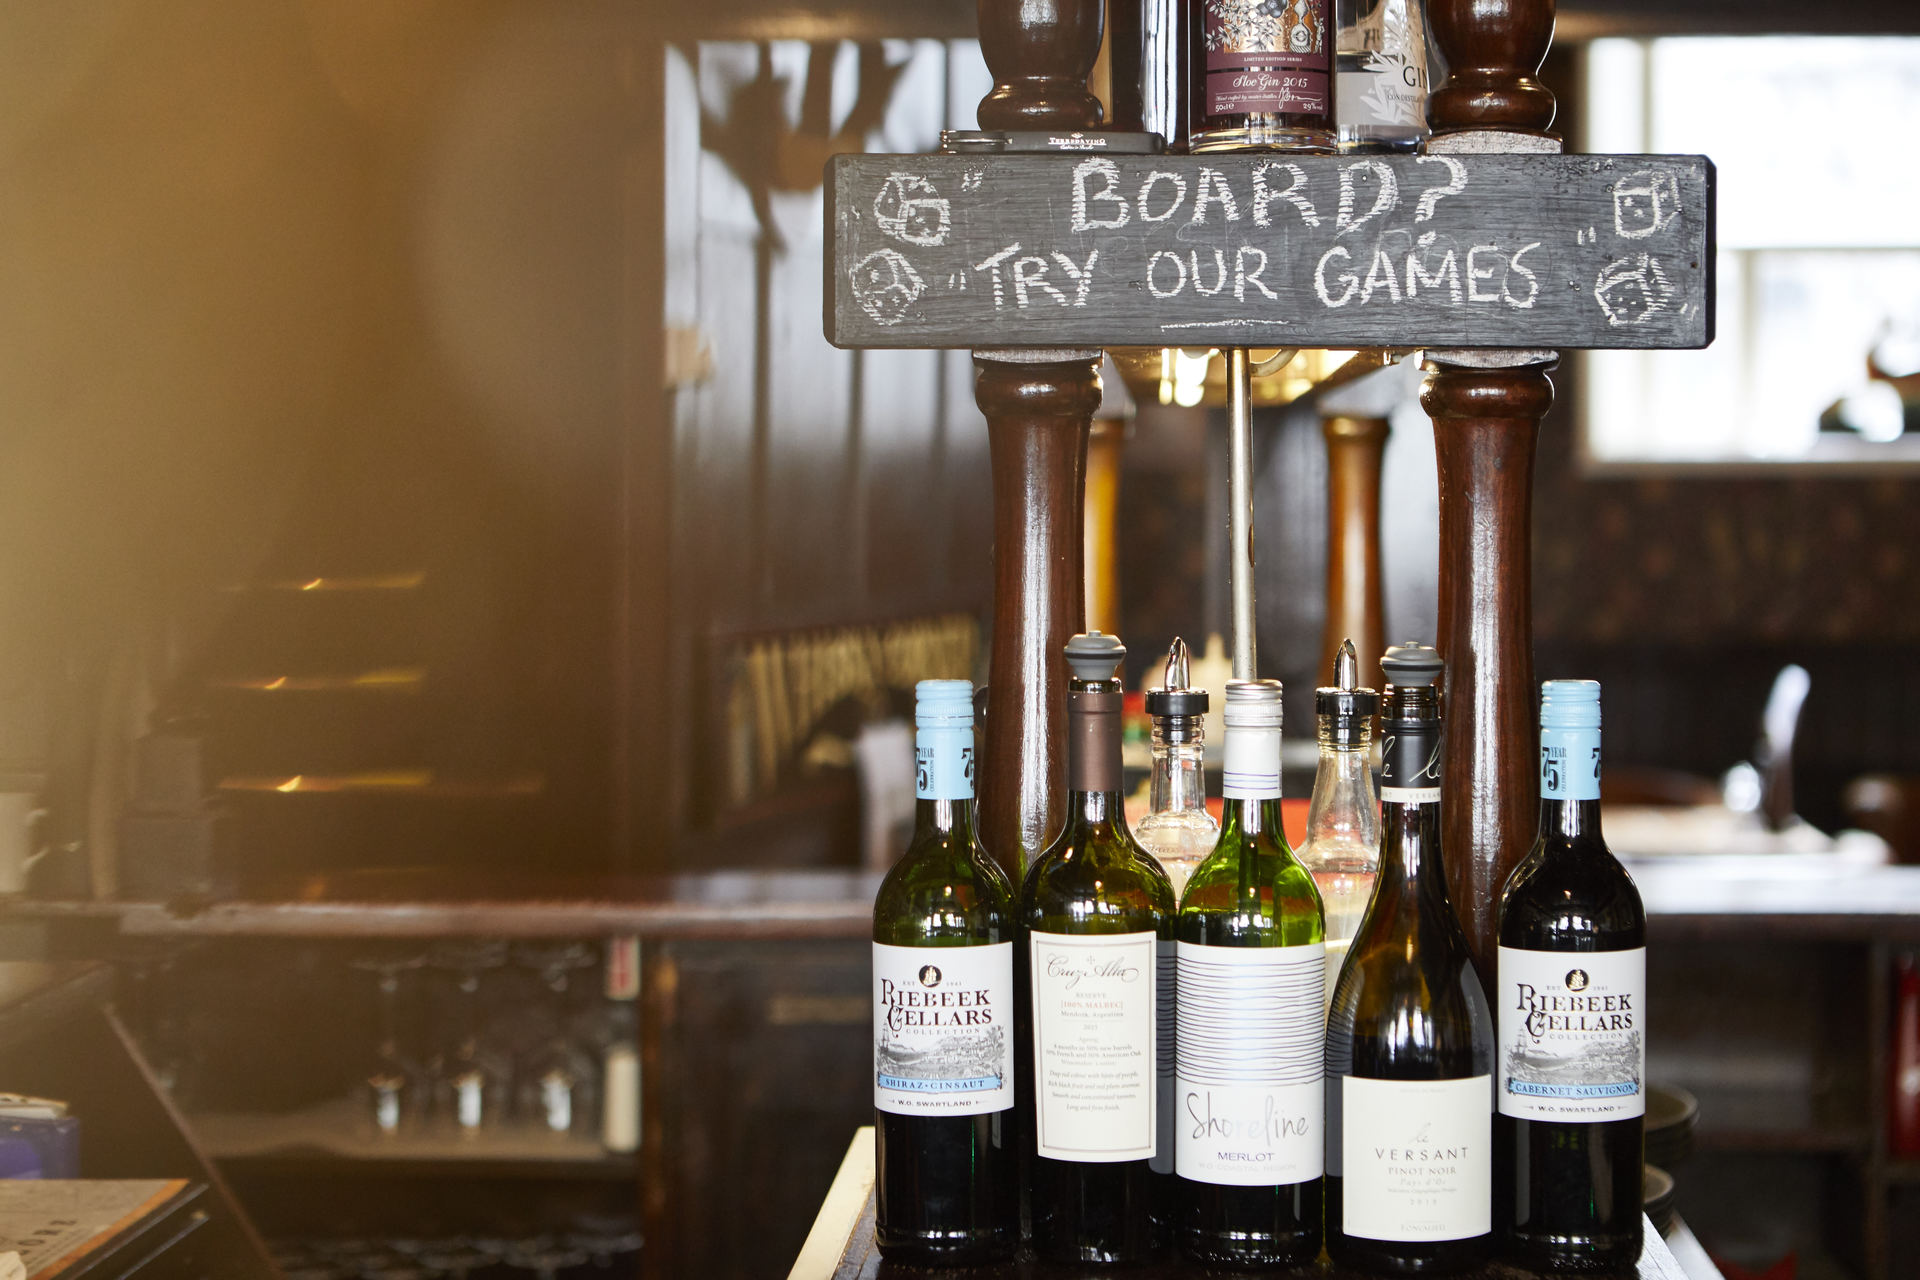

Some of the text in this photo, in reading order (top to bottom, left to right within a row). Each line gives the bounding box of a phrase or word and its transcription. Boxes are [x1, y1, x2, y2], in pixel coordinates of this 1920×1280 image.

[1233, 73, 1308, 91] Sloe Gin 2015
[1071, 155, 1468, 233] BOARD?
[974, 242, 1541, 310] TRY OUR GAMES
[881, 978, 991, 1008] RIEBEEK
[1516, 983, 1632, 1012] RIEBEEK
[887, 1006, 992, 1038] CELLARS
[1525, 1010, 1633, 1044] CELLARS
[906, 1028, 980, 1036] COLLECTION
[1550, 1032, 1623, 1040] COLLECTION
[1515, 1083, 1634, 1096] CABERNET SAUVIGNON
[1560, 1105, 1615, 1113] SWARTLAND
[1186, 1091, 1309, 1147] Shoreline
[1217, 1152, 1275, 1162] MERLOT
[1375, 1147, 1468, 1161] VERSANT
[1388, 1166, 1456, 1176] PINOT NOIR
